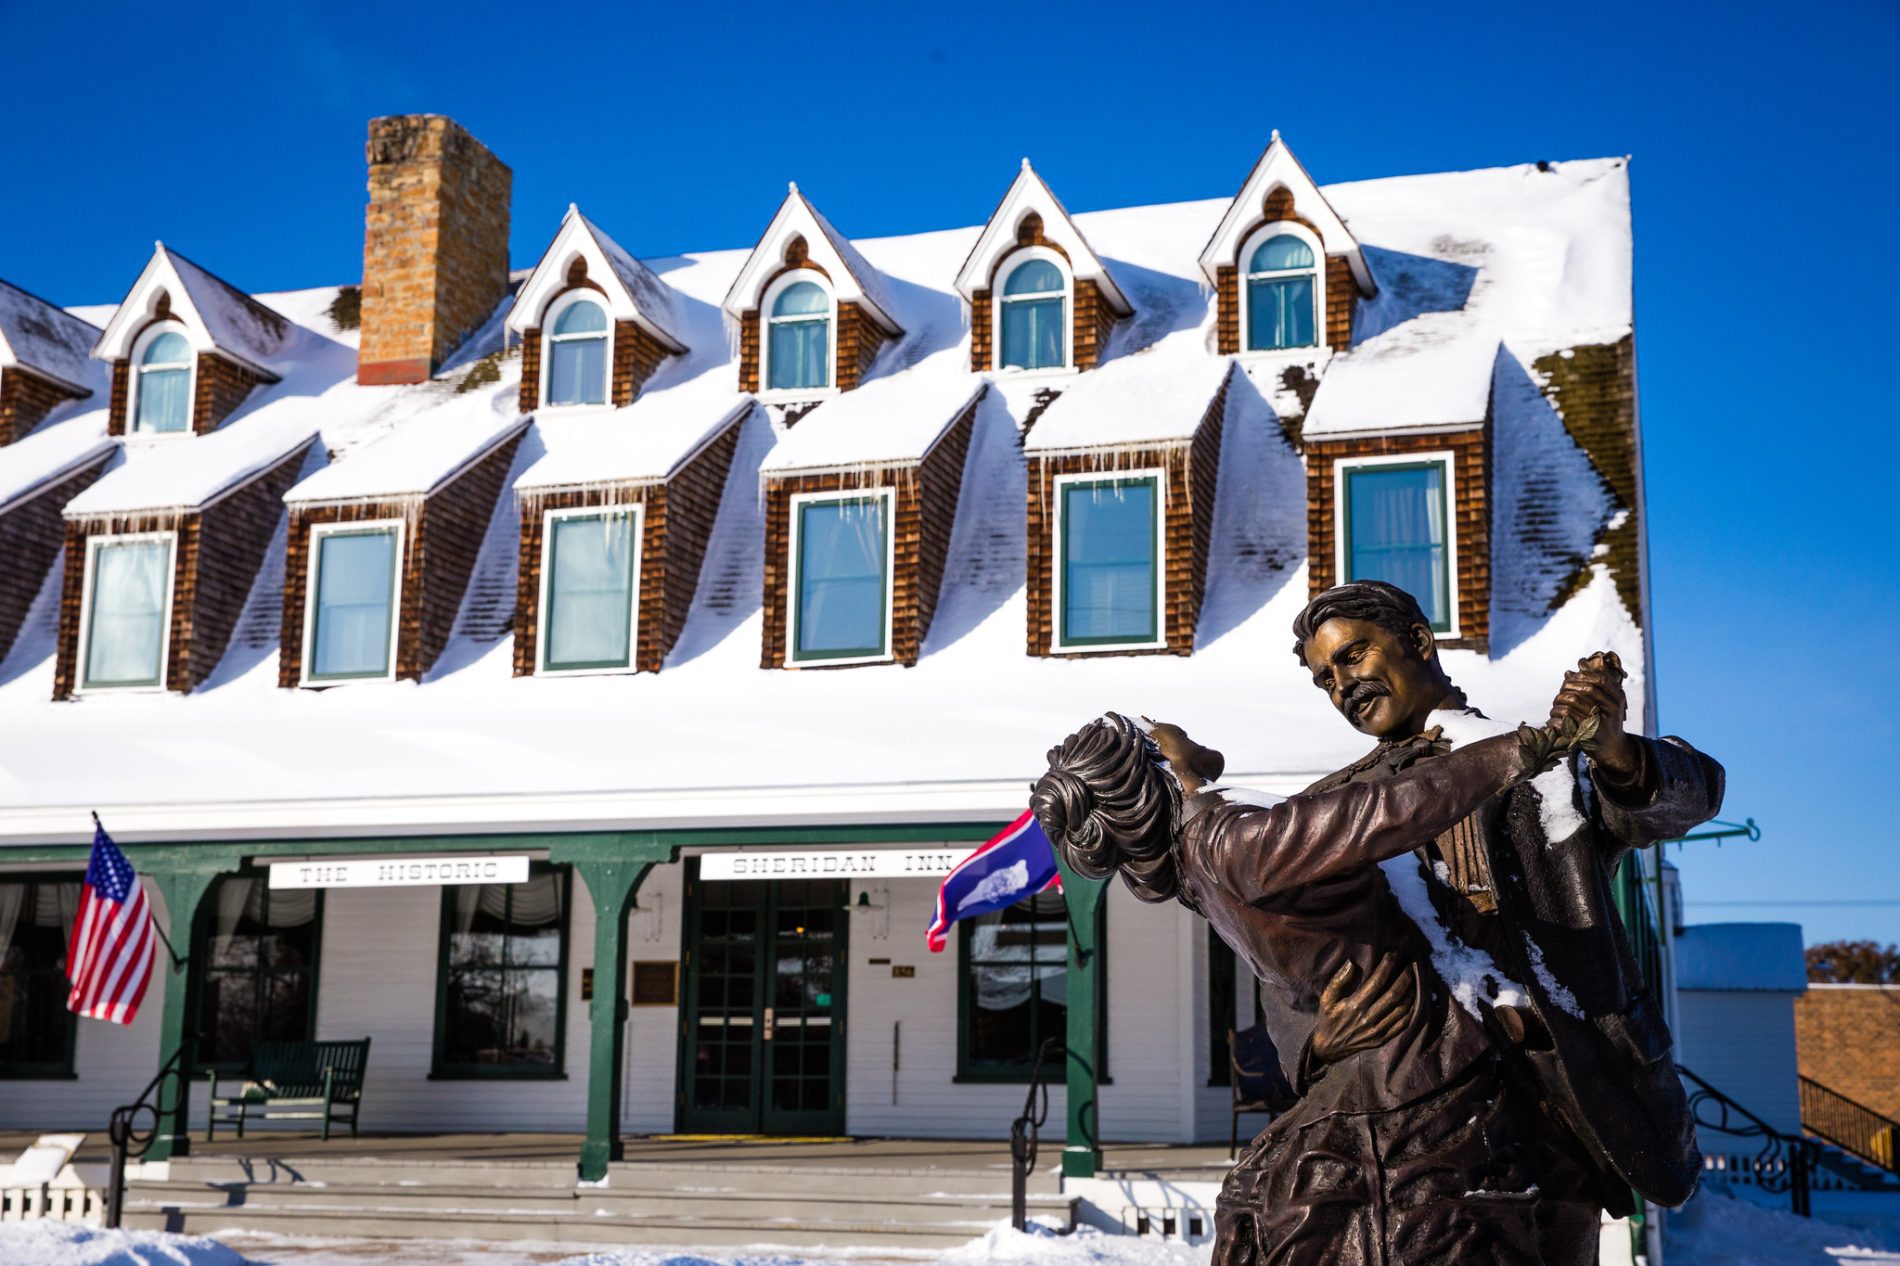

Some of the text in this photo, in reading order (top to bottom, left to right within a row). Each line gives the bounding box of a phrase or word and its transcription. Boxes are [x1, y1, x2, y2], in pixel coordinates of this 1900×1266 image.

[300, 862, 497, 882] THE HISTORIC
[733, 855, 953, 873] SHERIDAN INN
